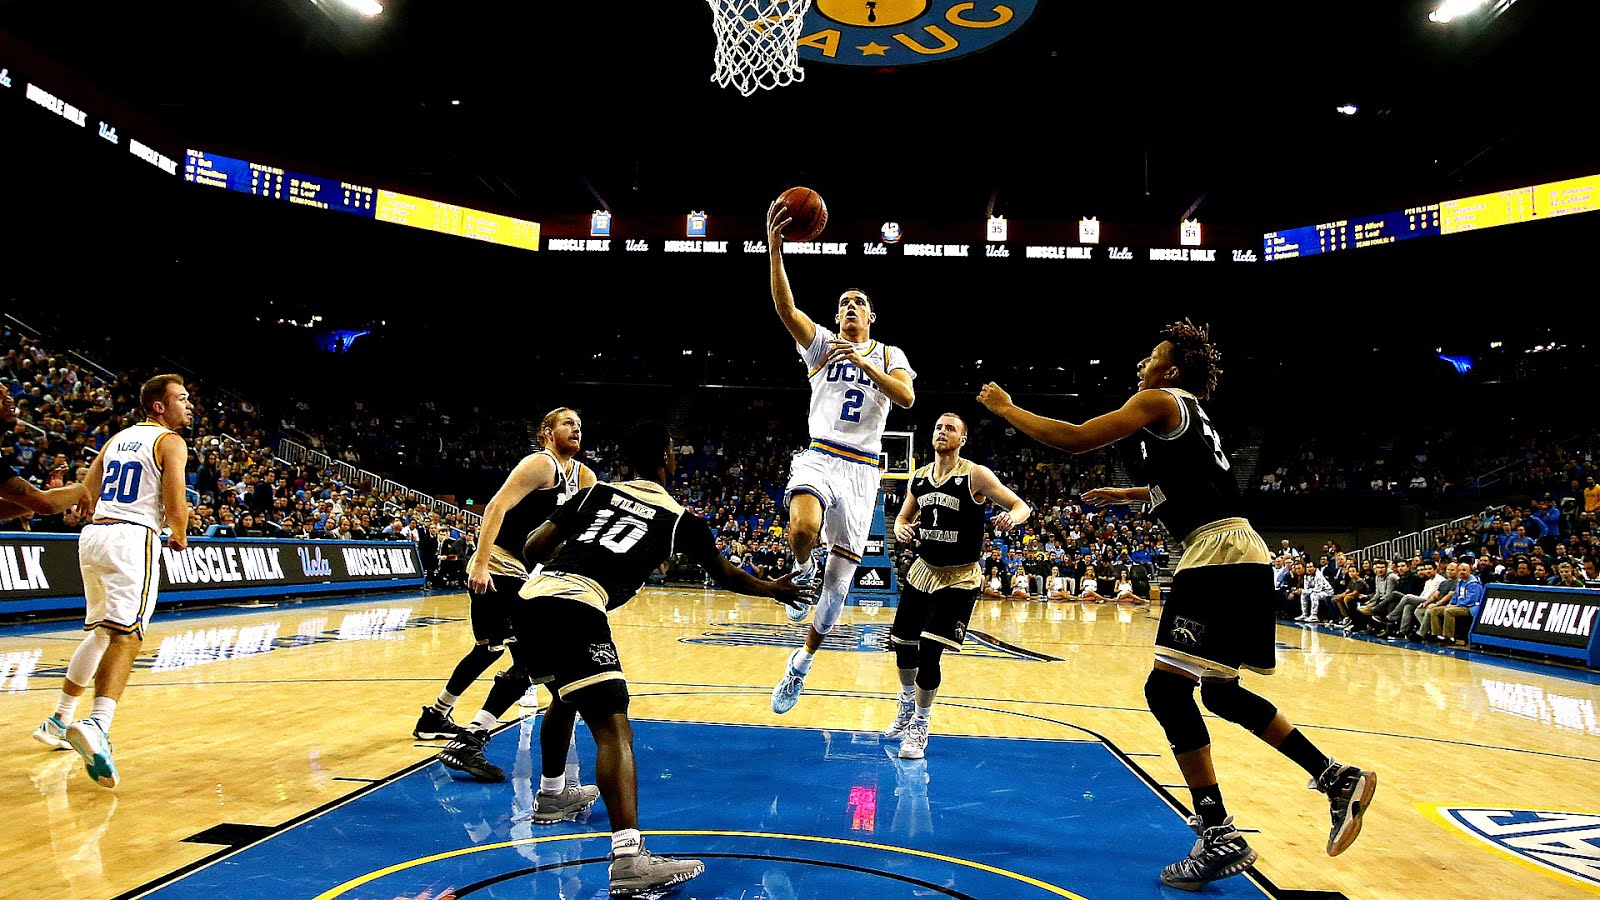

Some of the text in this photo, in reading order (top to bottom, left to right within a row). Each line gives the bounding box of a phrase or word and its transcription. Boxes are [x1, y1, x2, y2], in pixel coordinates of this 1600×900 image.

[549, 239, 585, 251] MUSCLE
[664, 241, 702, 252] MUSCLE
[783, 242, 821, 254] MUSCLE
[904, 244, 942, 256] MUSCLE
[1026, 246, 1065, 259] MUSCLE
[1150, 248, 1188, 261] MUSCLE
[826, 362, 878, 390] UCL
[840, 388, 865, 422] 2
[101, 460, 143, 504] 20
[610, 493, 656, 520] WILDER
[932, 508, 938, 528] 1
[576, 508, 648, 554] 10
[0, 546, 50, 590] ILK
[162, 546, 284, 584] MUSCLE MILK
[298, 546, 332, 577] Ucla
[342, 548, 416, 576] MUSCLE MILK
[1480, 598, 1598, 636] MUSCLE MILK
